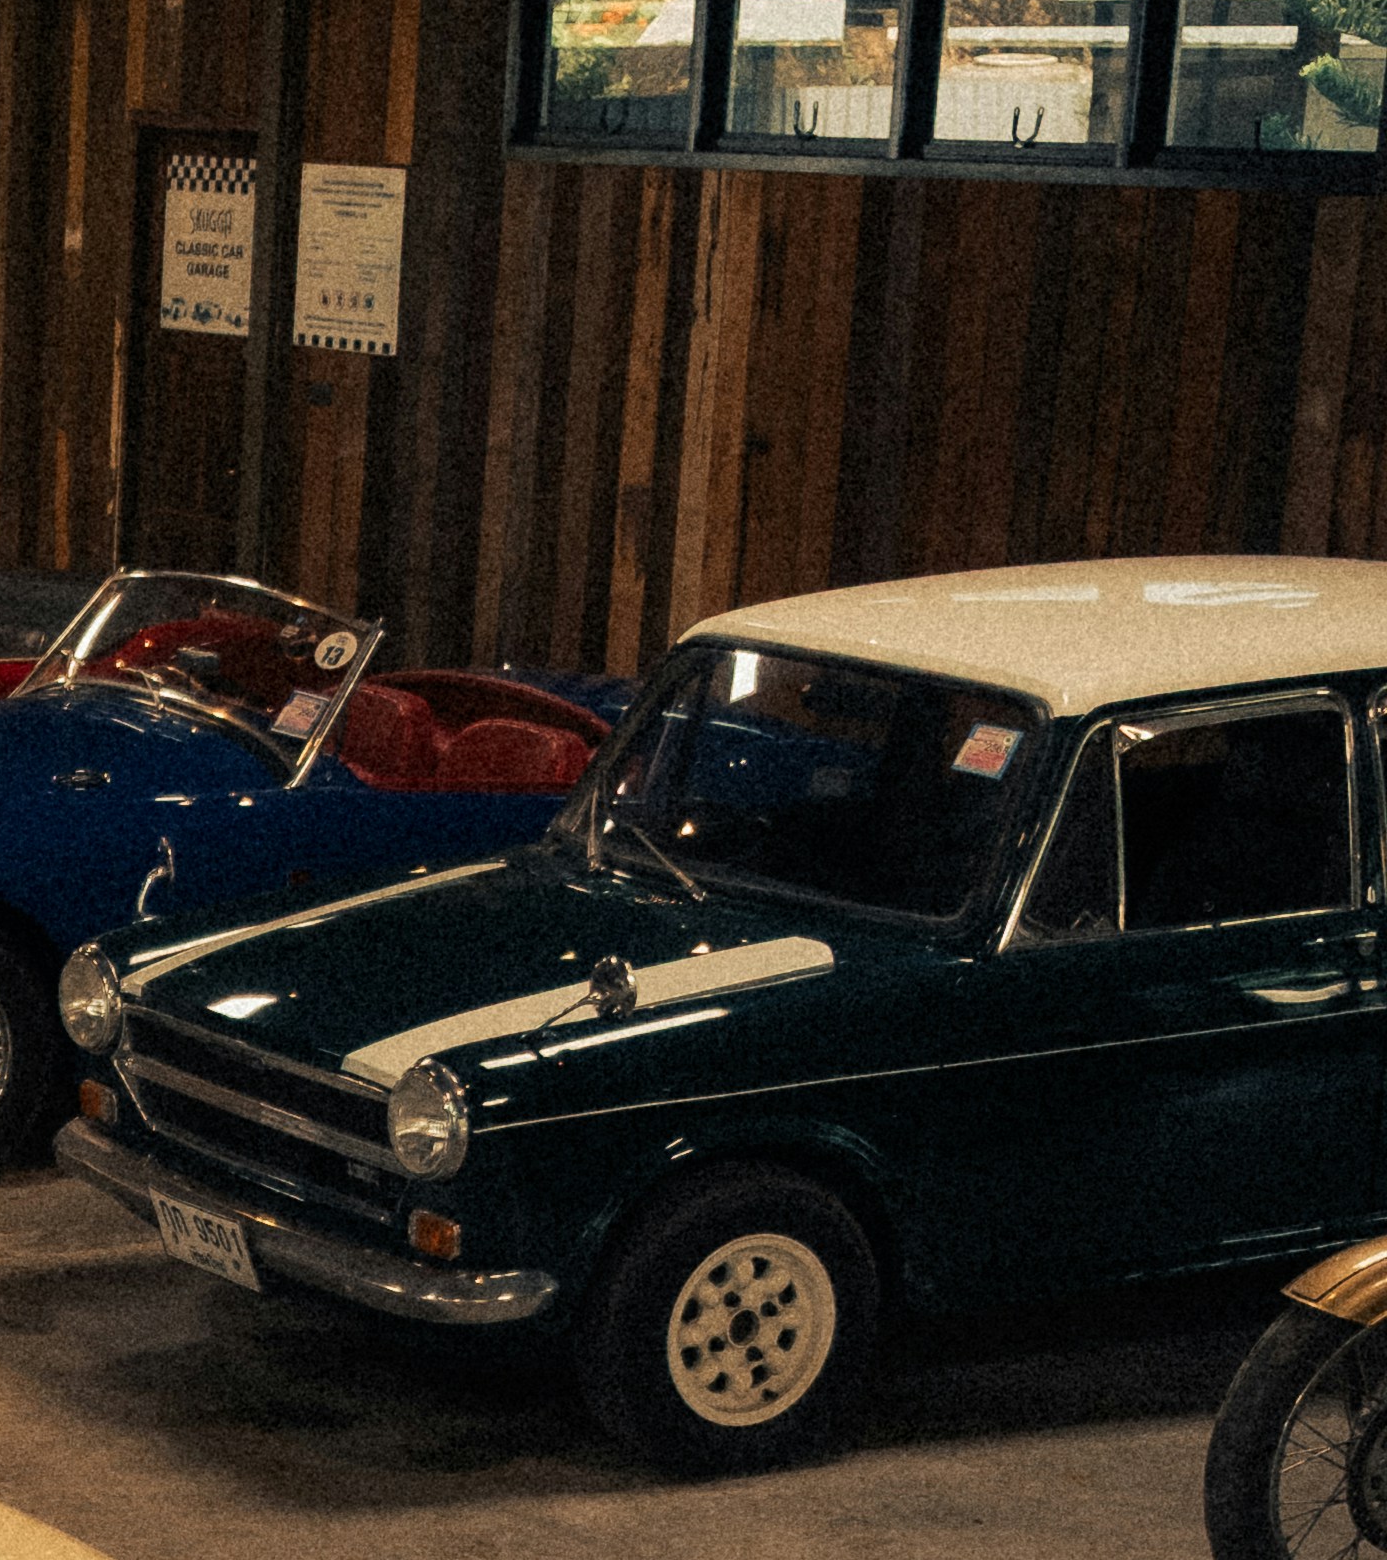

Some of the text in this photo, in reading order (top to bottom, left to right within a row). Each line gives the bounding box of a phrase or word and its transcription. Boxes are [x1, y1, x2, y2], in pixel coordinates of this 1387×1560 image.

[175, 240, 244, 260] CLASSIC CAR
[186, 262, 231, 279] GARAGE
[321, 646, 346, 666] 13
[192, 1214, 244, 1259] 9501
